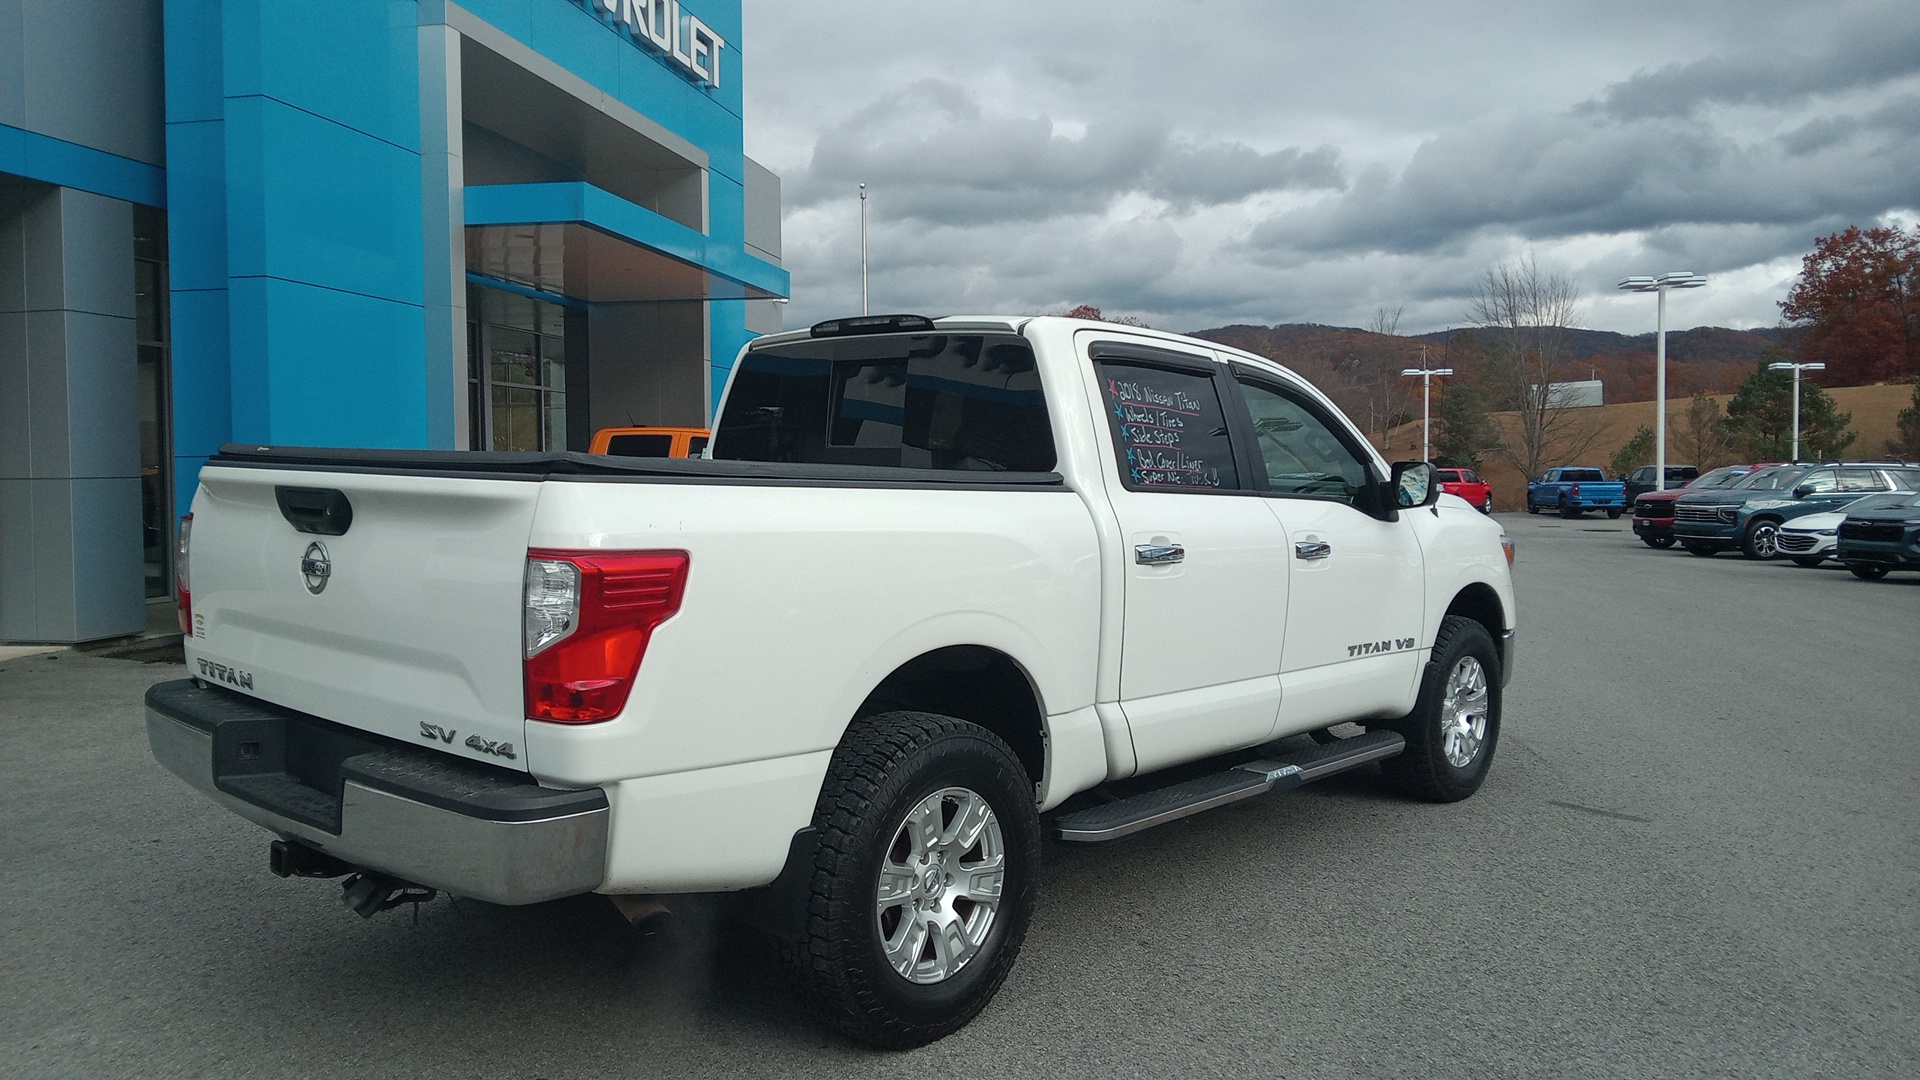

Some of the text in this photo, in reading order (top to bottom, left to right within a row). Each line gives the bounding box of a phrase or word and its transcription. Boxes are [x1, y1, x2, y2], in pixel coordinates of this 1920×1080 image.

[596, 0, 725, 89] ROLET
[1117, 381, 1142, 401] 2018
[1130, 426, 1180, 448] Side Steps
[1141, 470, 1165, 484] Super
[1347, 640, 1391, 657] TITAN
[196, 657, 254, 690] TITAN
[420, 720, 457, 744] SV
